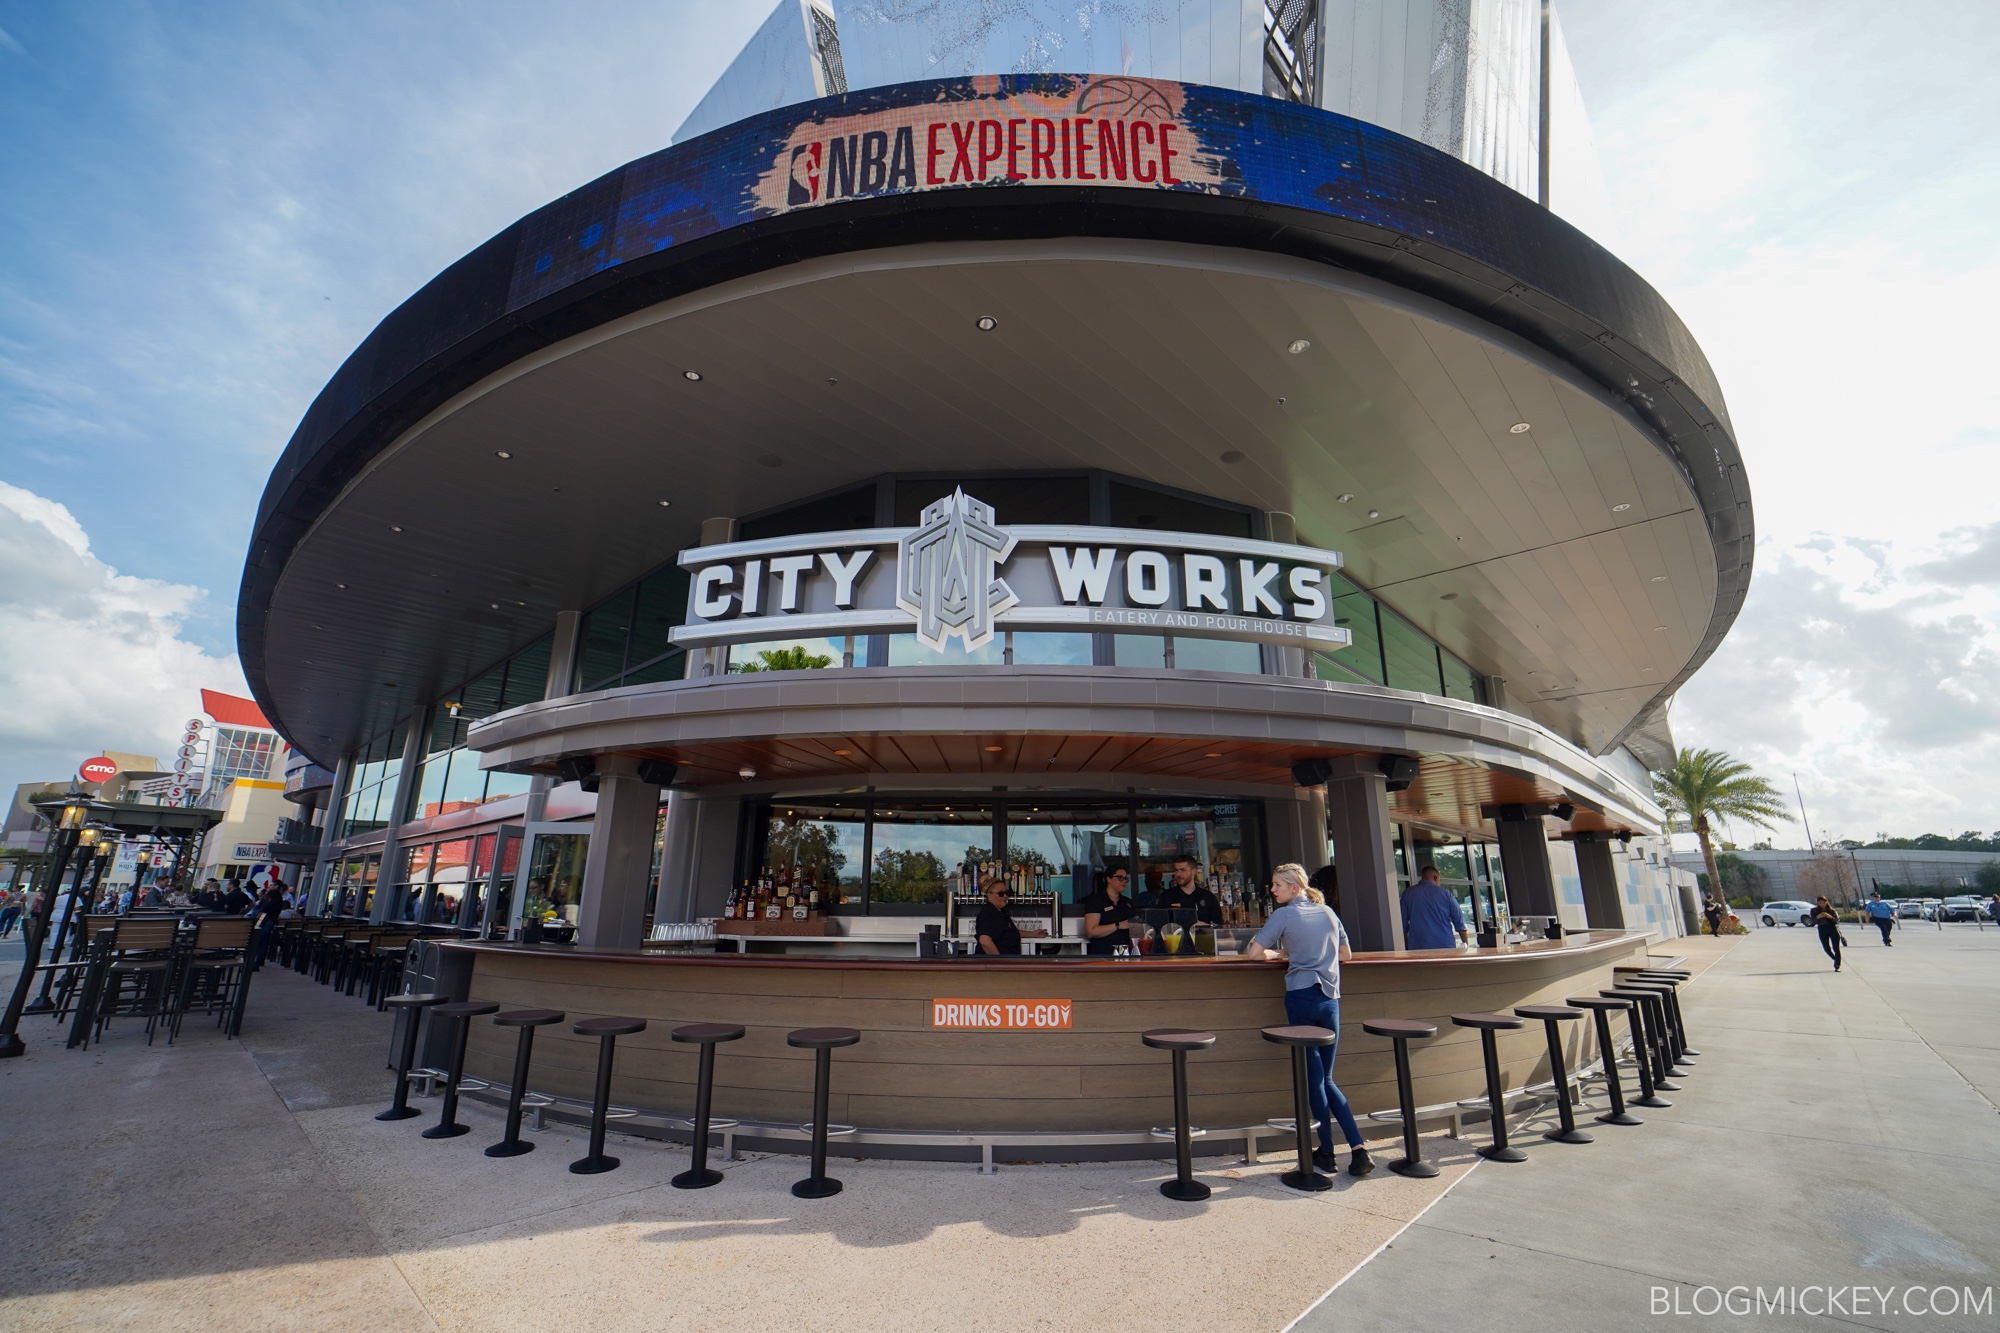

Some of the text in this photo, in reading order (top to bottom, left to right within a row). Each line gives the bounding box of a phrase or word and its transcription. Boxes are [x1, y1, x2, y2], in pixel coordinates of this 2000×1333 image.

[825, 117, 1182, 199] NBA EXPERIENCE
[694, 546, 1327, 620] CITY WORKS
[1093, 610, 1303, 637] EATERY AND POUR HOUSE
[235, 846, 251, 857] NBA
[934, 1004, 1060, 1027] DRINKS TO-GO
